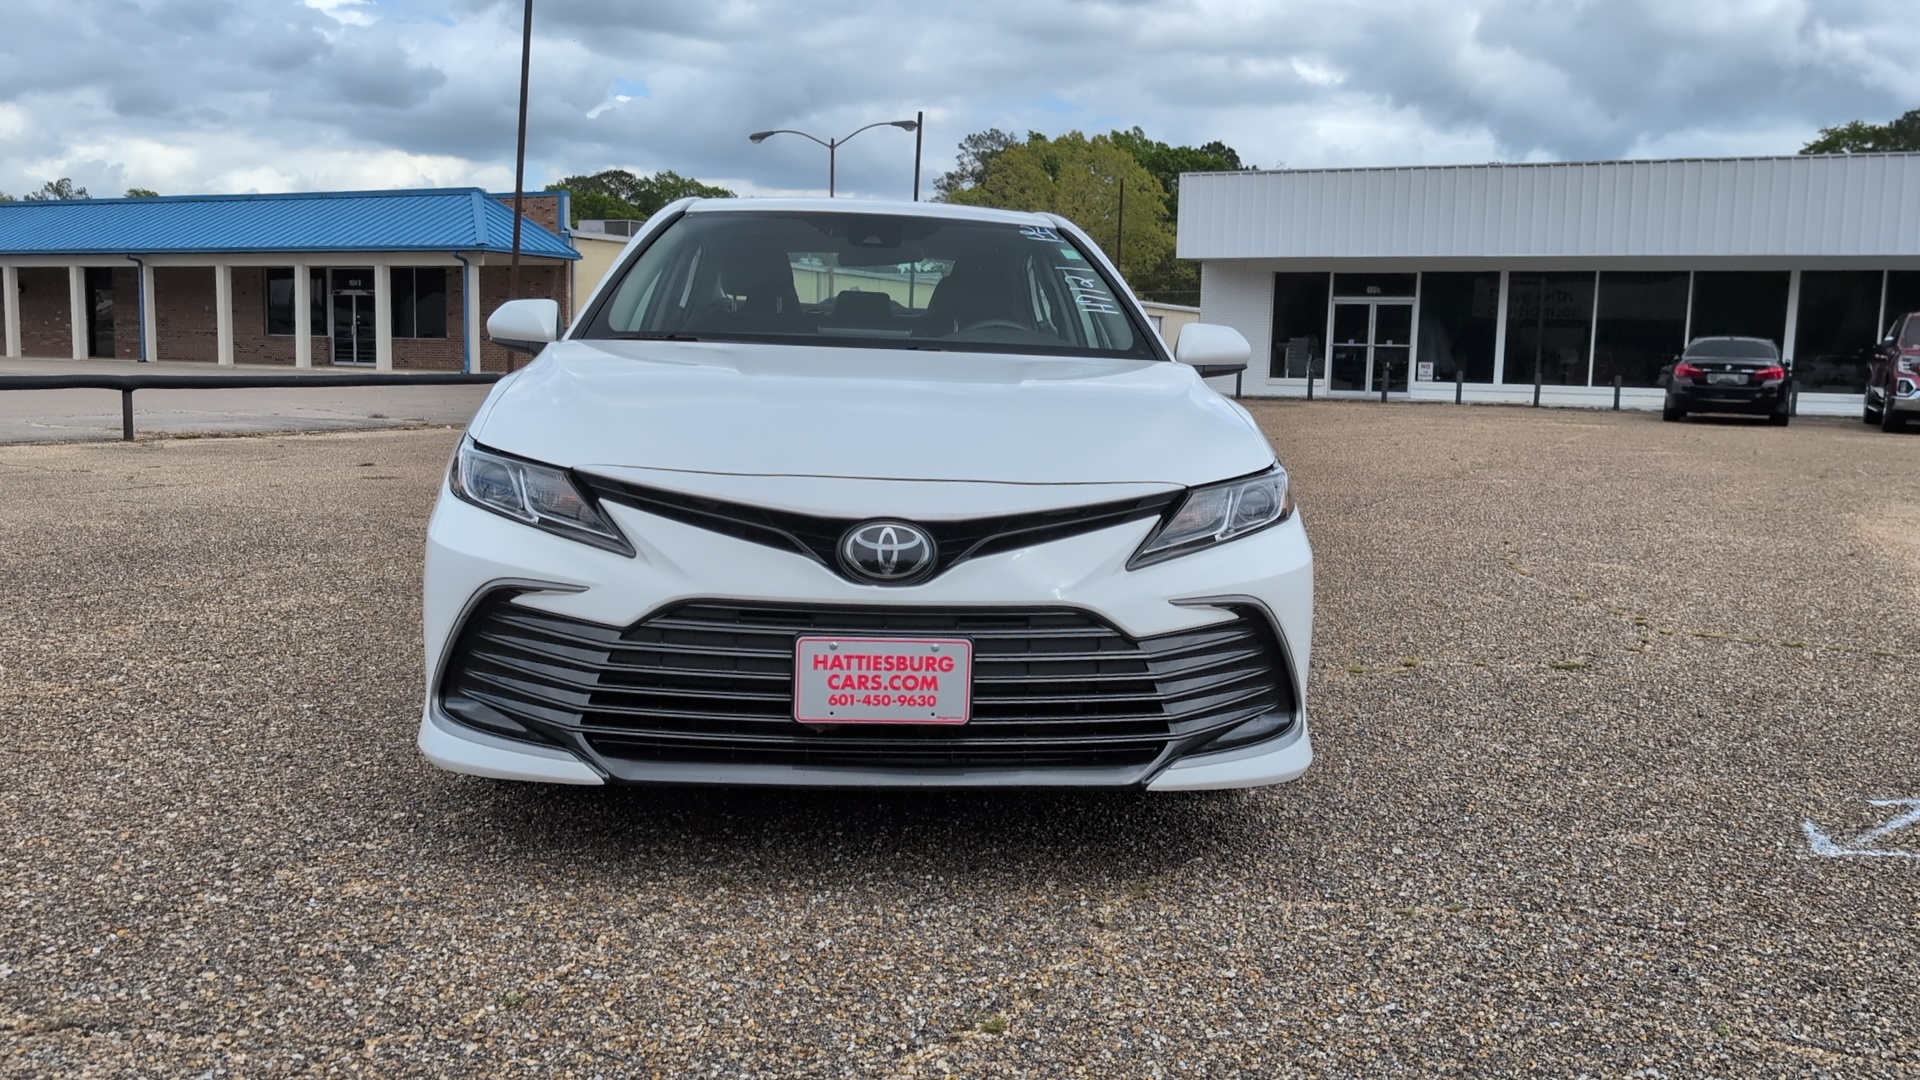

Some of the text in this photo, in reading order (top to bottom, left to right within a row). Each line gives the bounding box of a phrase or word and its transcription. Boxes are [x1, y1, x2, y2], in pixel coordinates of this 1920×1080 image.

[813, 654, 954, 672] HATTIESBURG
[828, 675, 939, 691] CARS.COM
[829, 694, 937, 706] 601-450-9630
